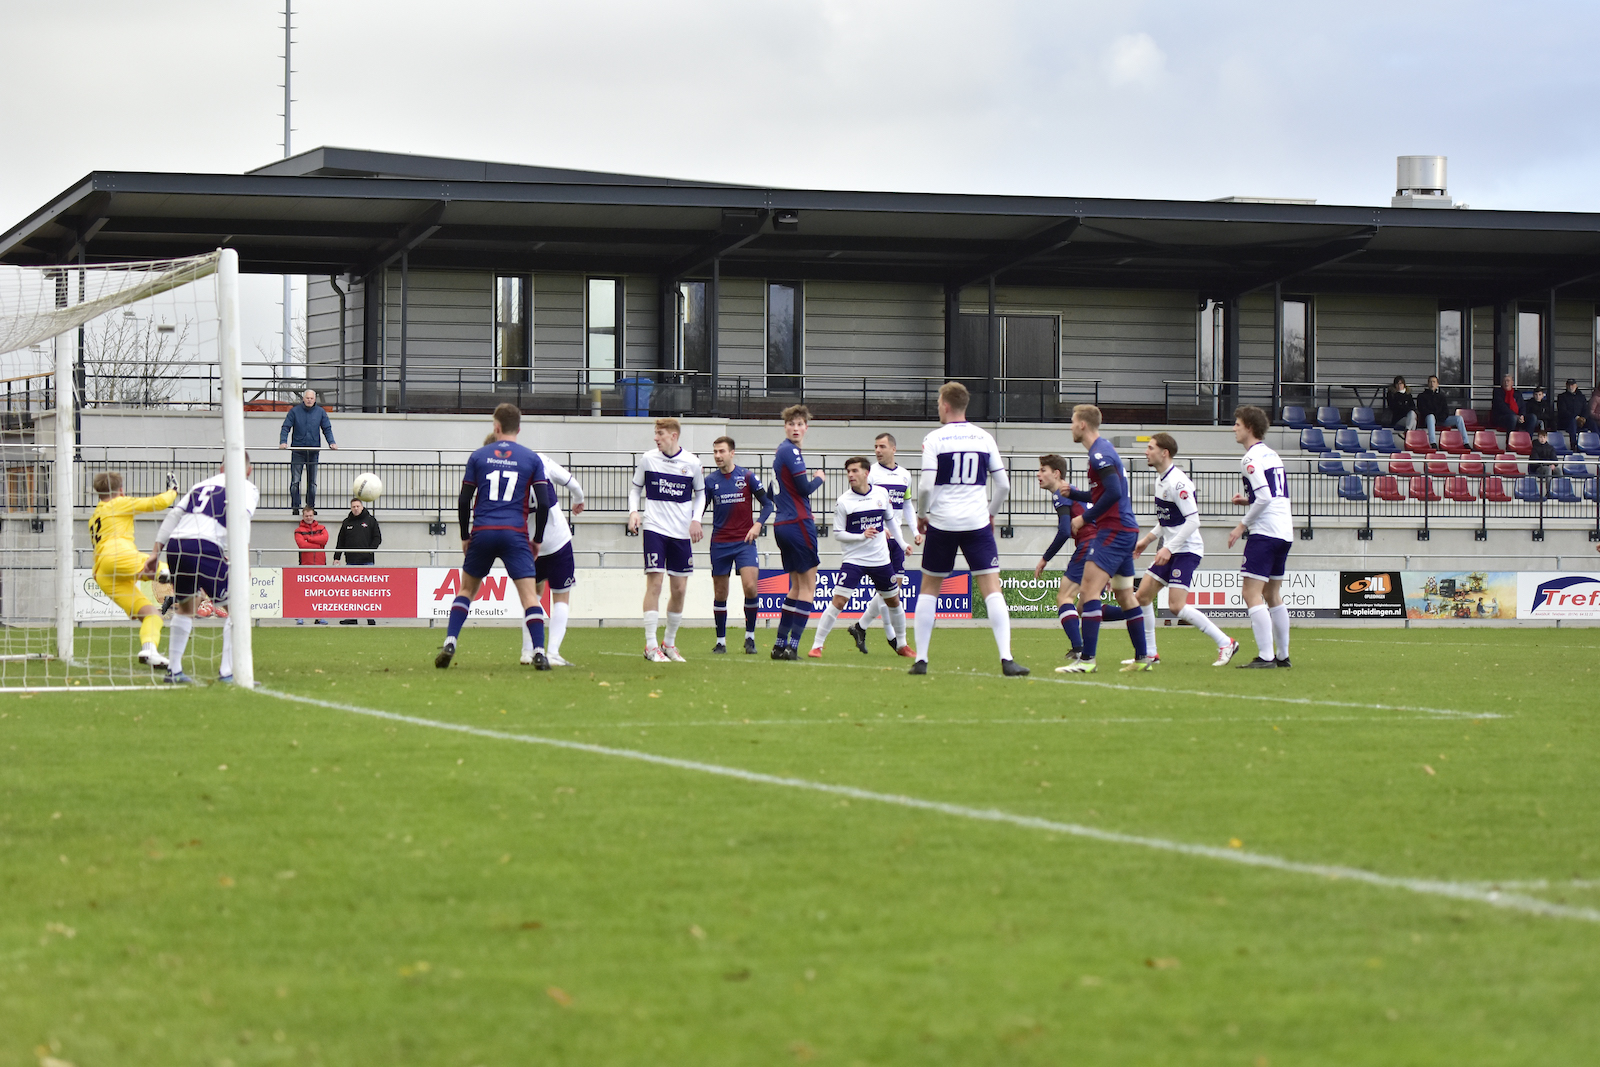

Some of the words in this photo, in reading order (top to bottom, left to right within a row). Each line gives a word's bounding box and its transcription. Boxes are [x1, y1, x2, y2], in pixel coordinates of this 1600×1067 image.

[487, 458, 518, 466] Noordam
[950, 452, 979, 485] 10
[486, 470, 518, 502] 17
[659, 478, 686, 489] Ekeren
[660, 485, 684, 497] Kuiper
[193, 485, 215, 513] 5
[647, 552, 659, 567] 12
[251, 576, 275, 586] Proef
[297, 575, 389, 583] RISICOMANAGEMENT
[433, 568, 508, 601] AN
[838, 572, 848, 585] 2
[999, 577, 1061, 589] rthodonti
[1364, 576, 1386, 592] ML
[259, 588, 268, 598] &
[304, 588, 350, 597] EMPLOYEE
[352, 588, 392, 597] BENEFITS
[1543, 590, 1600, 606] Tref
[311, 603, 382, 611] VERZEKERINGEN
[758, 597, 783, 609] ROC
[937, 597, 969, 609] ROCH
[1296, 610, 1306, 618] 03
[1306, 610, 1316, 618] 55
[1342, 607, 1402, 617] ml-opleidingen.nl
